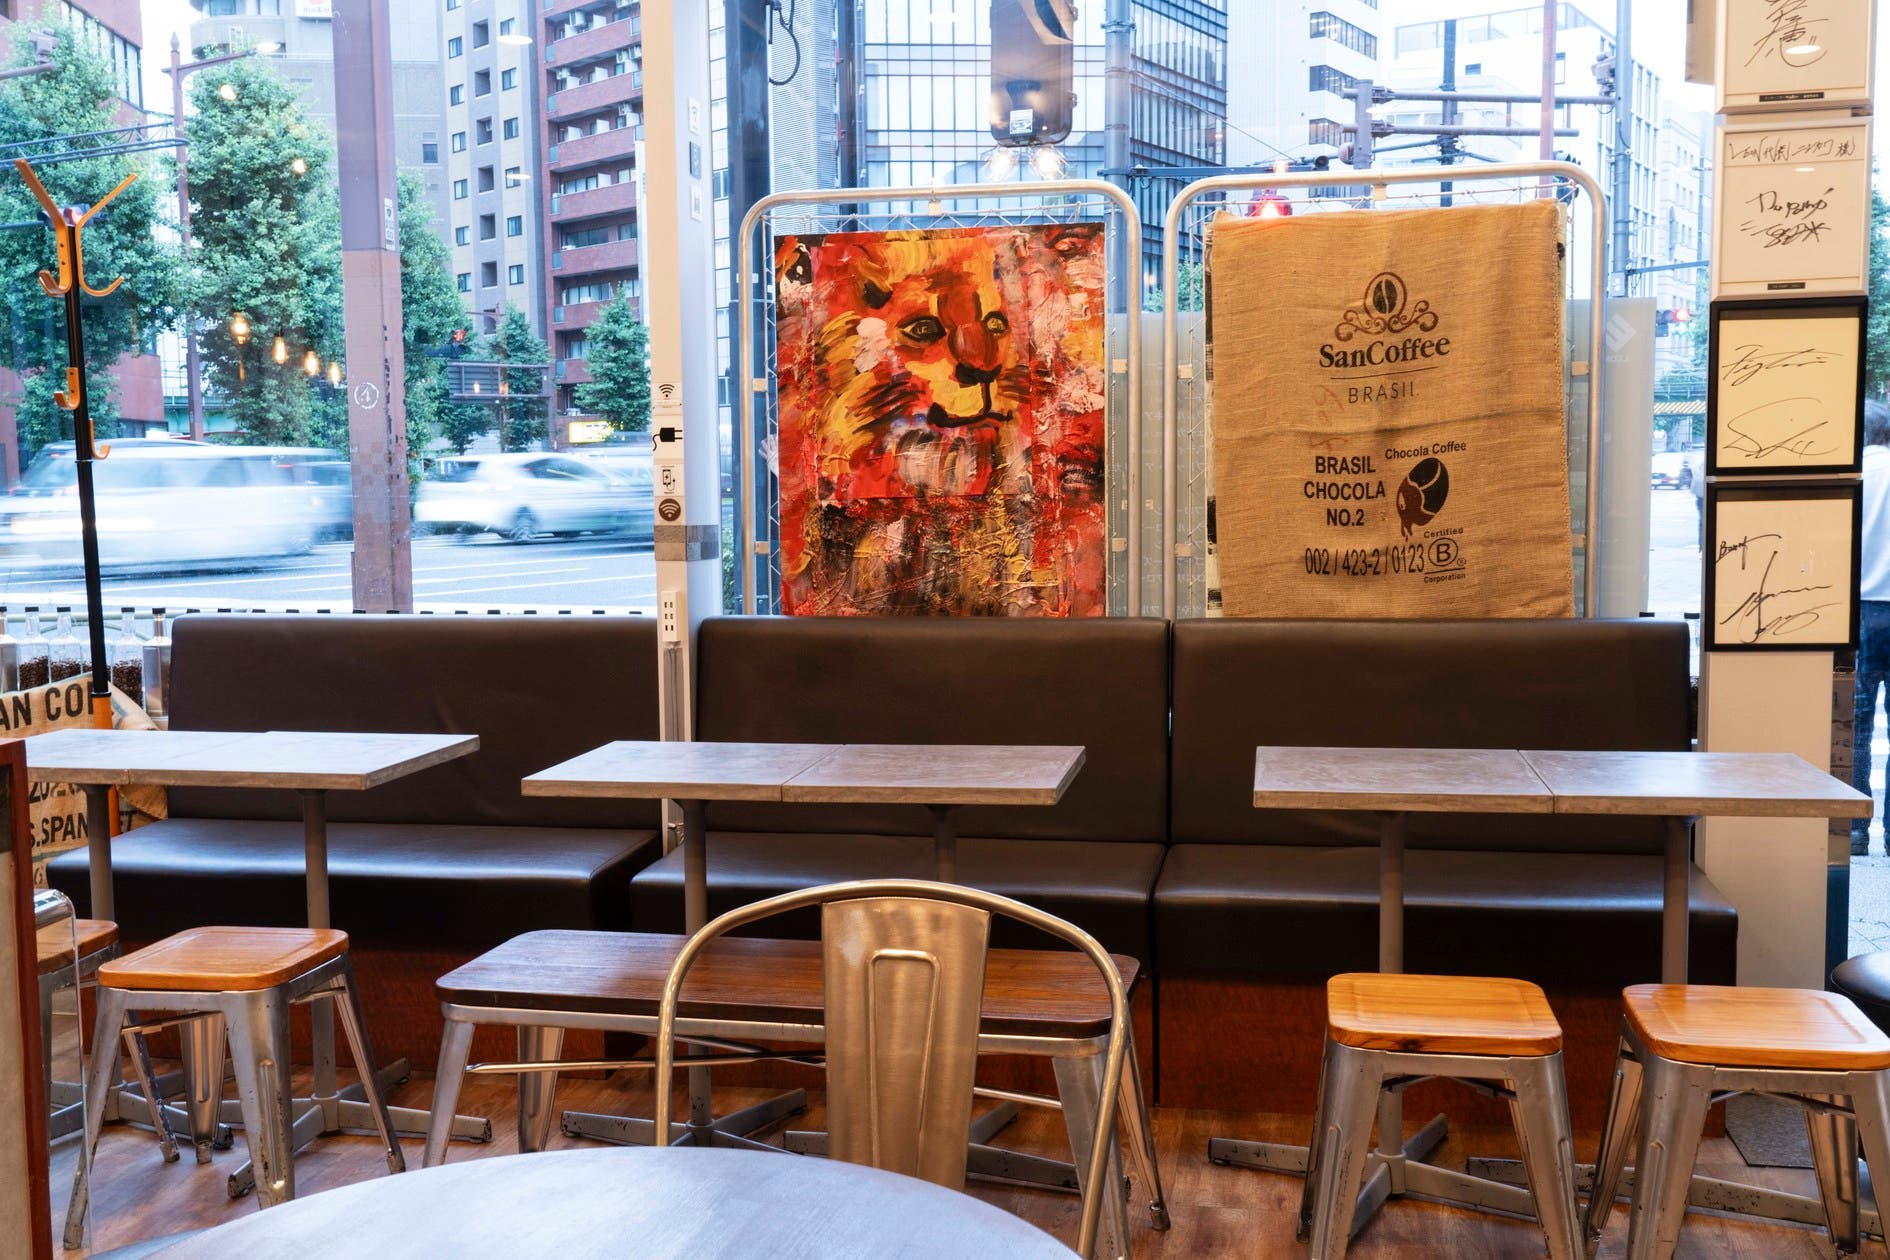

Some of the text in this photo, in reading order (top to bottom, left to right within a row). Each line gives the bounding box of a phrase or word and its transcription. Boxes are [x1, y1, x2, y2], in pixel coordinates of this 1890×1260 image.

[1319, 337, 1450, 368] SanCoffee
[1348, 381, 1419, 404] BRASIL
[1385, 441, 1467, 460] Chocola Coffee
[1315, 455, 1376, 475] BRASIL
[1303, 480, 1386, 500] CHOCOLA
[1327, 508, 1365, 527] NO.2
[1423, 528, 1464, 539] Certified
[1305, 547, 1330, 575] 002
[1342, 547, 1381, 576] 423-2
[1391, 543, 1425, 574] 0123
[1423, 573, 1466, 584] Corporation
